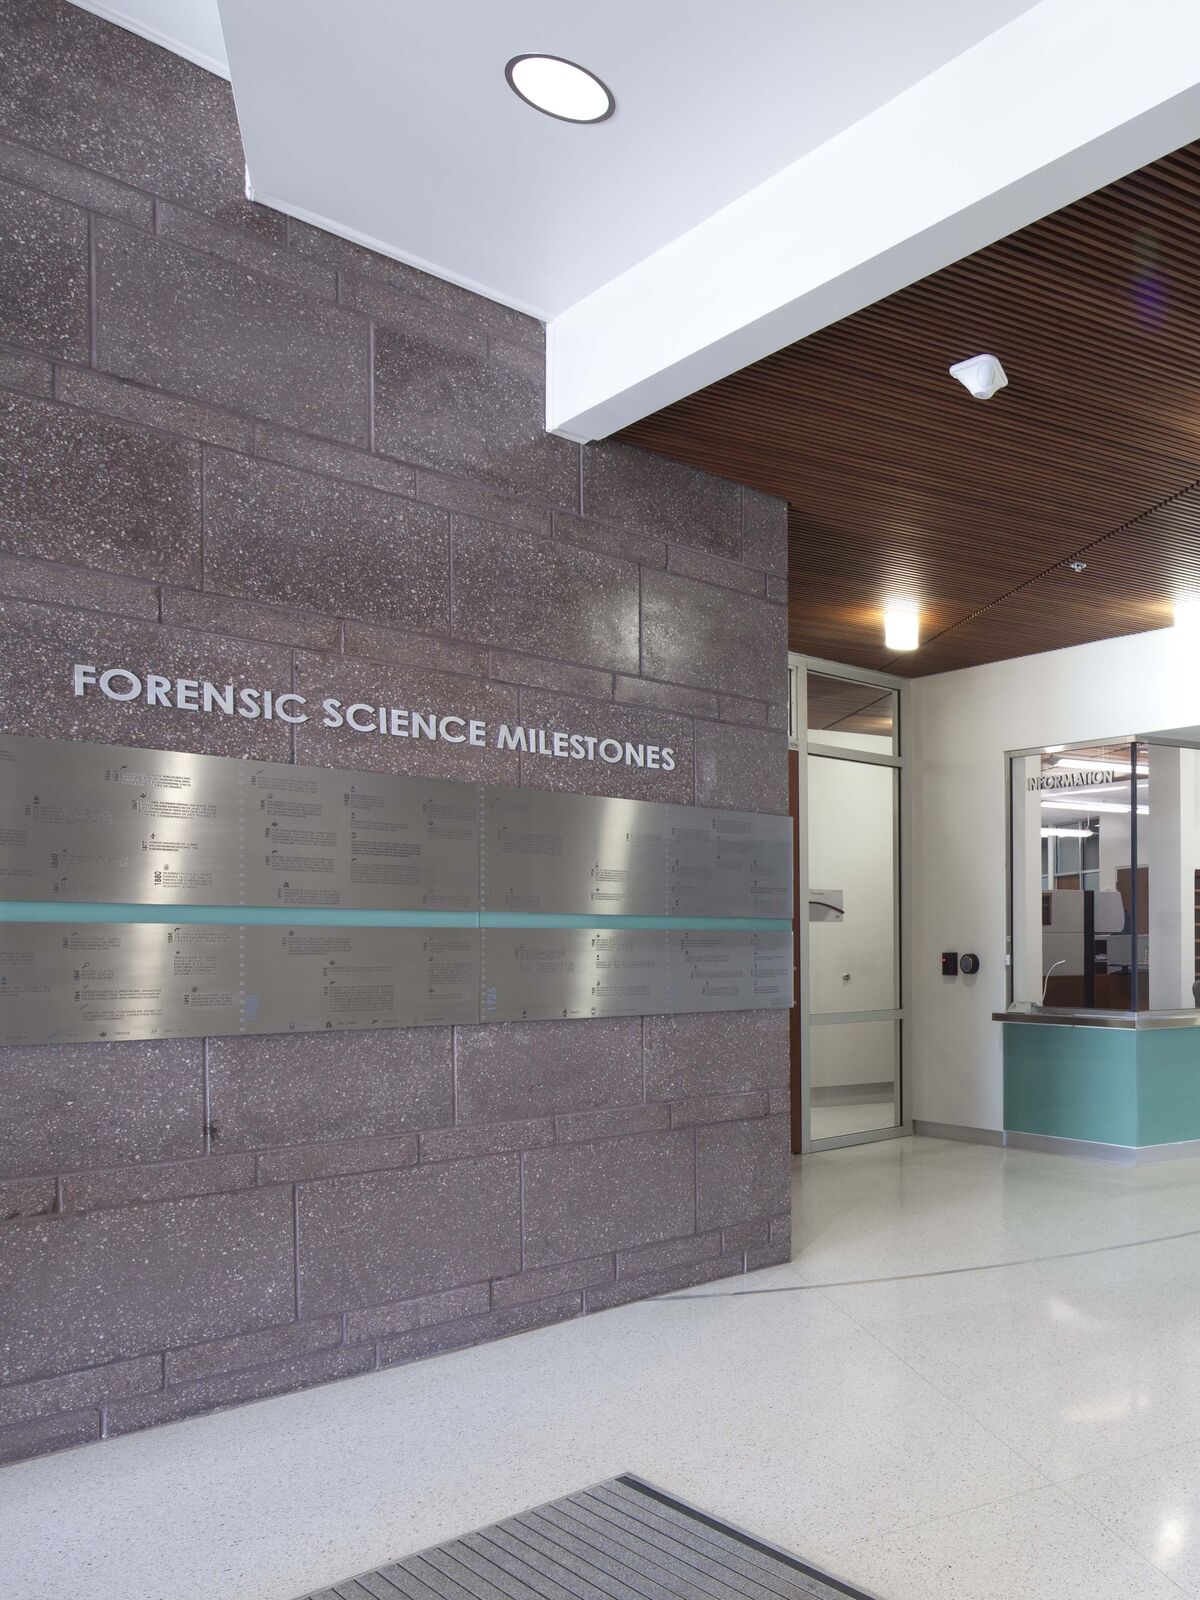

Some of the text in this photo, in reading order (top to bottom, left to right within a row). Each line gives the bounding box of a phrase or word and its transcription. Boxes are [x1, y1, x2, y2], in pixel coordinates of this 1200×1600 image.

[74, 664, 676, 771] FORENSIC SCIENCE MILESTONES
[1026, 770, 1115, 791] INFORMATION
[154, 870, 162, 886] 1880
[487, 987, 497, 1011] 1925
